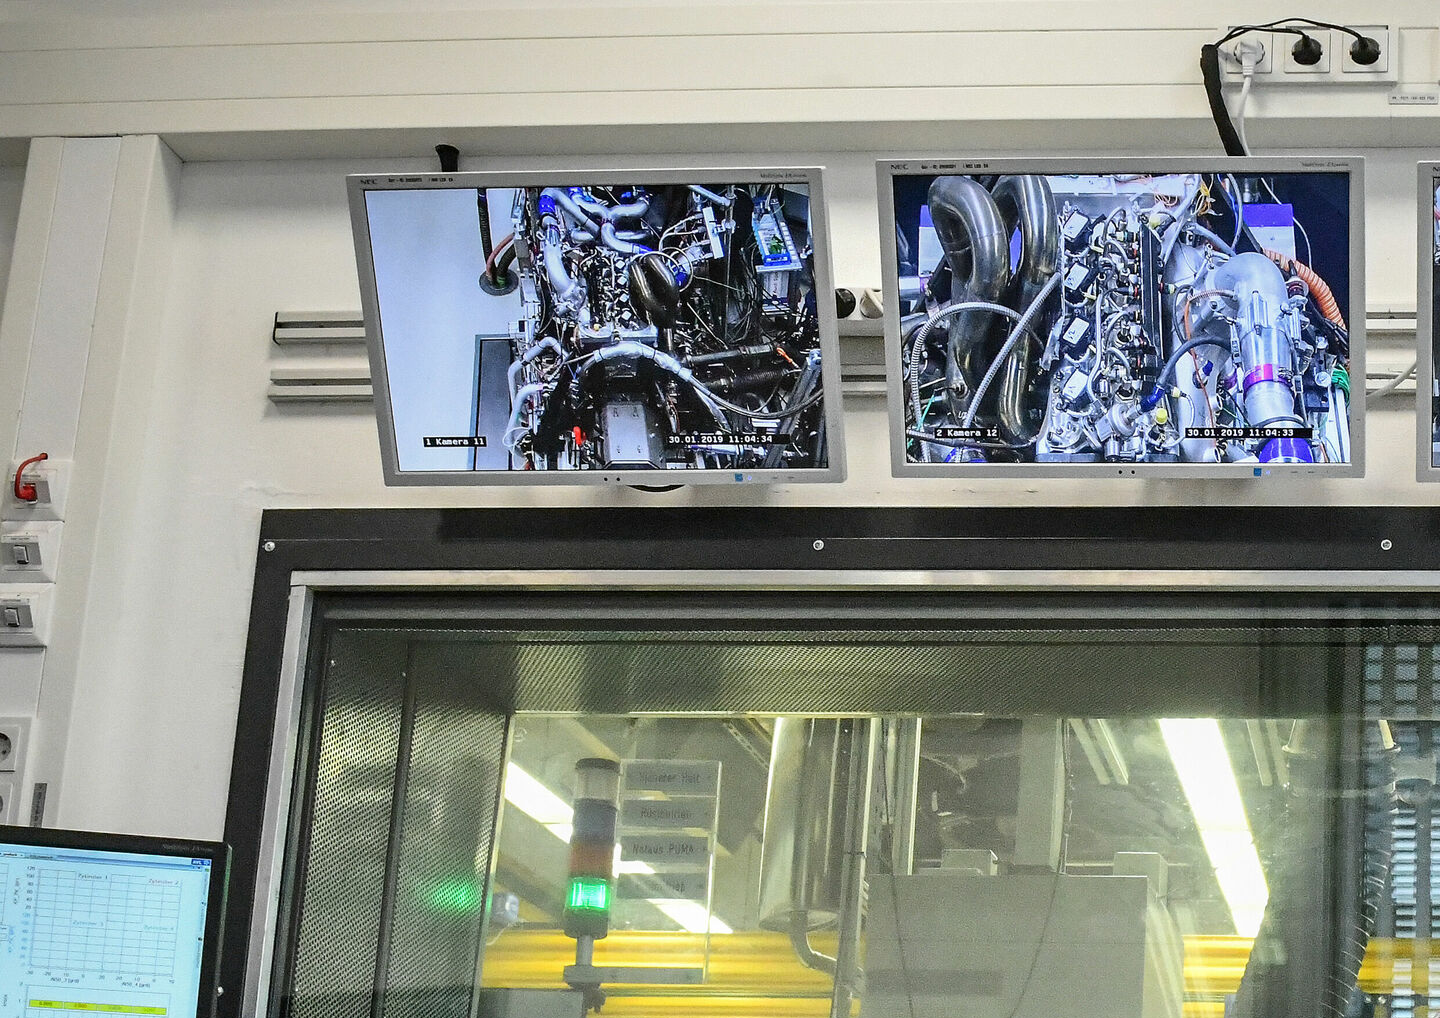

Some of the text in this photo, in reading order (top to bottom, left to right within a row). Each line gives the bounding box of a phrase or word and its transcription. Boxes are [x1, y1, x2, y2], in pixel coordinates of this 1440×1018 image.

[947, 429, 981, 437] Kamera
[986, 429, 998, 437] 12
[1187, 428, 1294, 437] 30.01.2019 11:04:33
[435, 438, 469, 446] Kamera
[474, 437, 485, 445] 11
[669, 435, 773, 443] 30.01.2019 11:04:34
